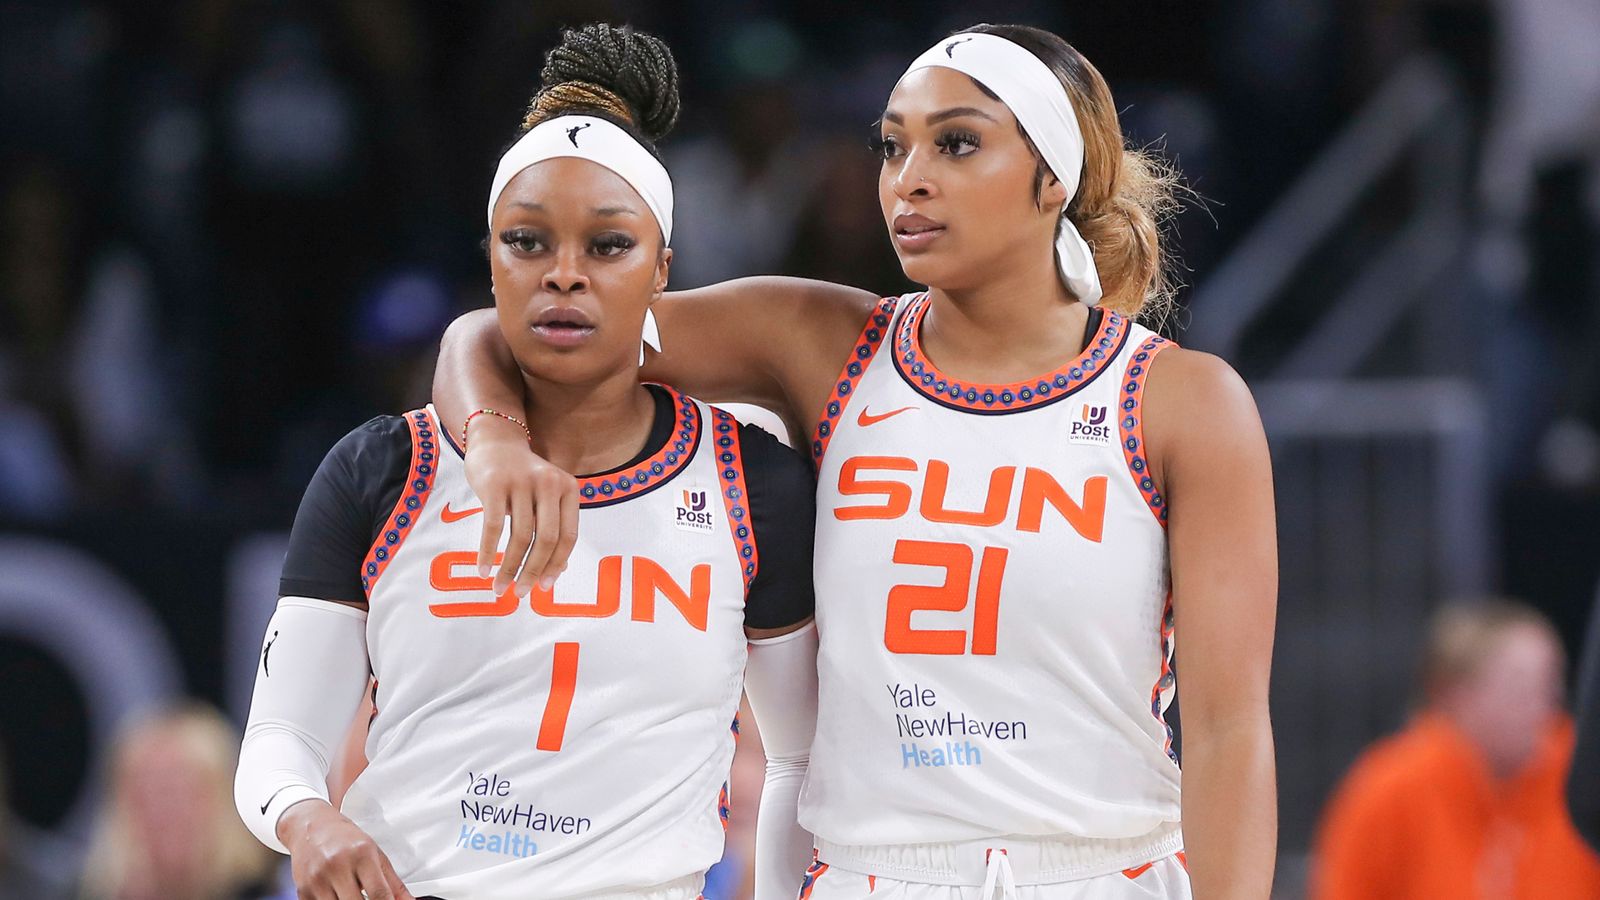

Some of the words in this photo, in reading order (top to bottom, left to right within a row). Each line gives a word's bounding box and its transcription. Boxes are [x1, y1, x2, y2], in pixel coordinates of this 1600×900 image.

[1071, 421, 1110, 438] Post
[834, 455, 1108, 543] SUN
[676, 507, 712, 525] Post
[429, 551, 711, 632] SUN
[884, 539, 1009, 656] 21
[536, 642, 580, 752] 1
[886, 683, 936, 708] Yale
[896, 712, 1026, 740] NewHaven
[901, 741, 982, 769] Health
[466, 772, 511, 797] Yale
[461, 800, 591, 835] NewHaven
[456, 824, 538, 858] Health
